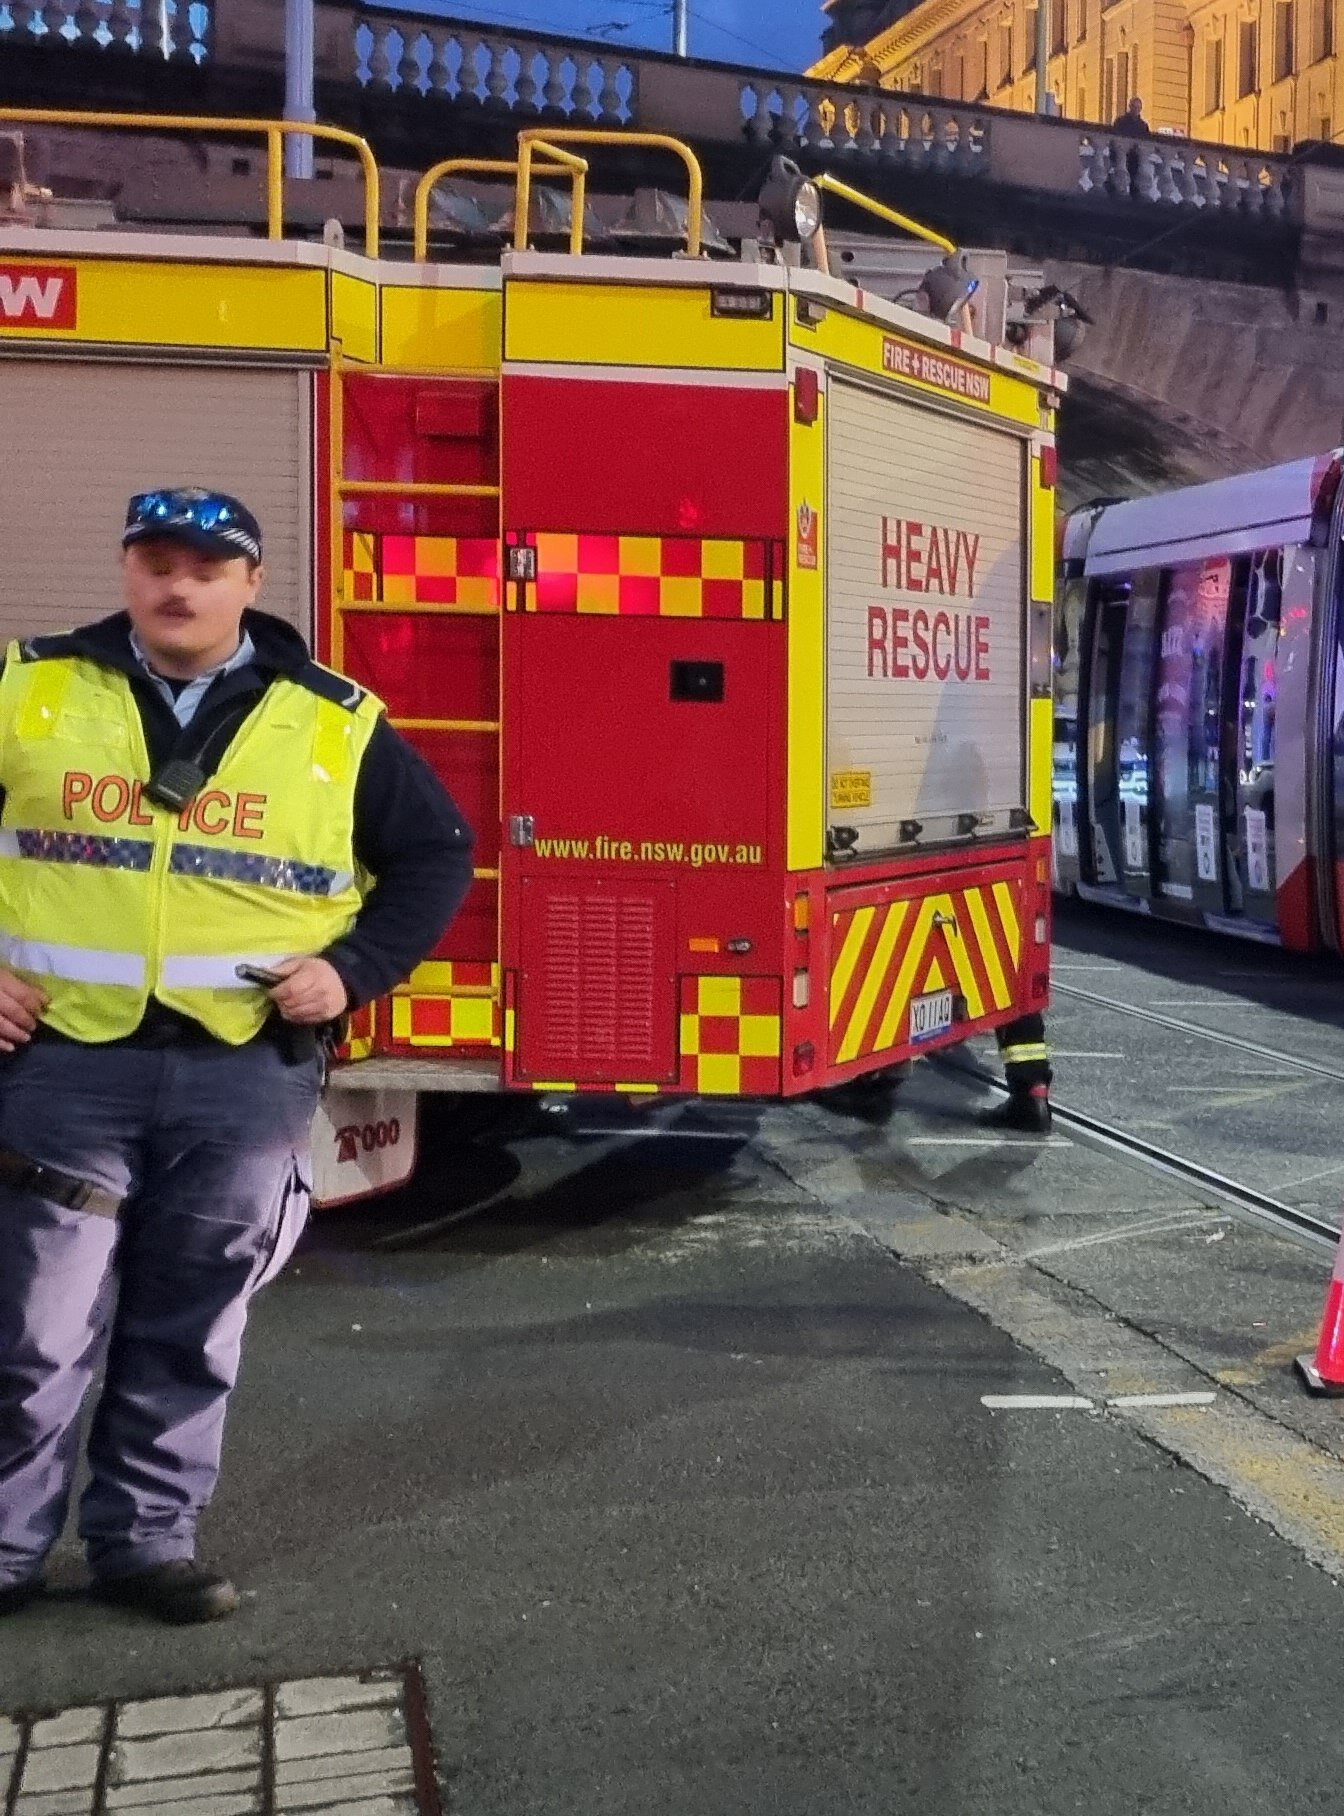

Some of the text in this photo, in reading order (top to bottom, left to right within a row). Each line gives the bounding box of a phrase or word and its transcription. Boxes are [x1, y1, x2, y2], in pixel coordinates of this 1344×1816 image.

[883, 342, 989, 400] FIRE RESCUE NSW
[881, 515, 980, 599] HEAVY
[867, 605, 990, 682] RESCUE
[63, 771, 268, 840] POLICE
[534, 836, 762, 868] www.fire.nsw.gov.au
